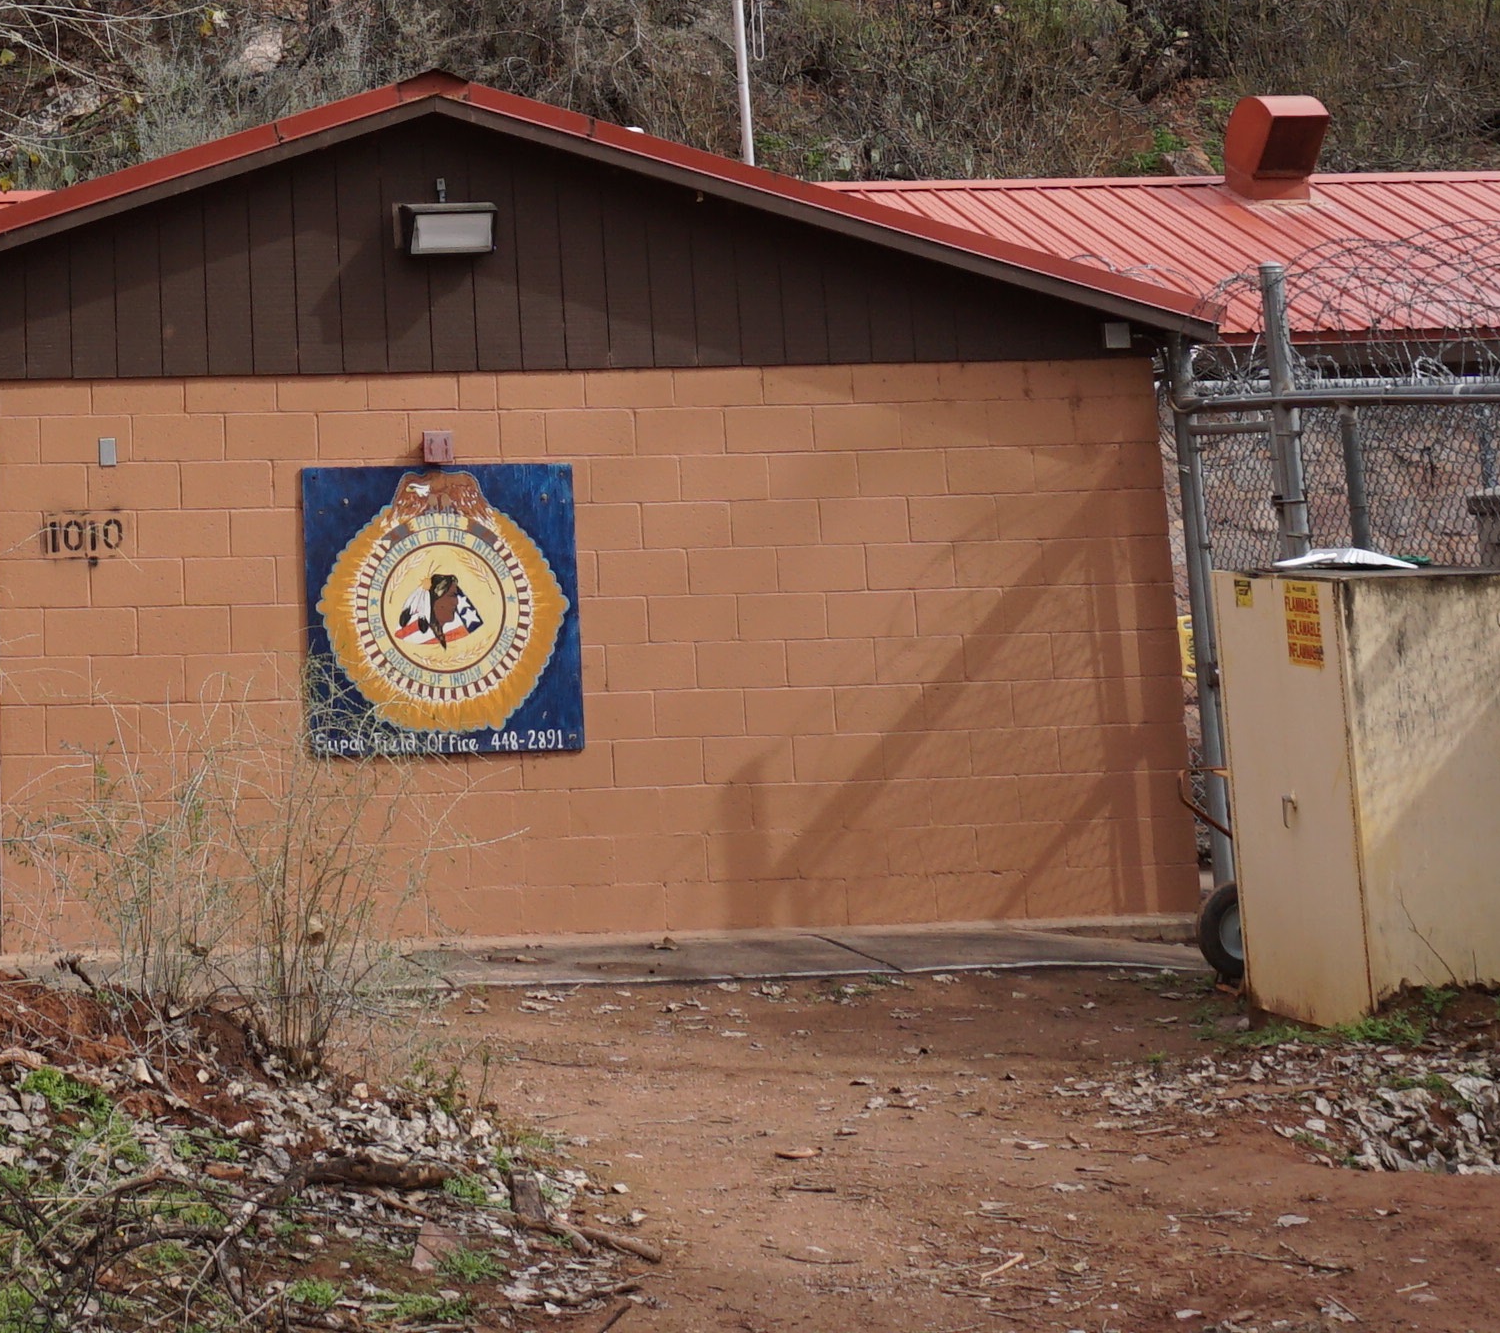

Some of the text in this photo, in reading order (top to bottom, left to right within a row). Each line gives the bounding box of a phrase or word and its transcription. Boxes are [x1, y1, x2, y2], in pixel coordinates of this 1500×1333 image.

[415, 514, 460, 528] POLICE
[46, 518, 124, 554] 1010
[371, 528, 511, 591] DEPARTMENT OF THE INTERIOR
[1284, 595, 1320, 615] FLAMMABLE
[369, 613, 386, 639] 1849
[384, 626, 516, 687] BUREAU OF INDIAN AFFAIRS
[491, 729, 564, 751] 448-2891
